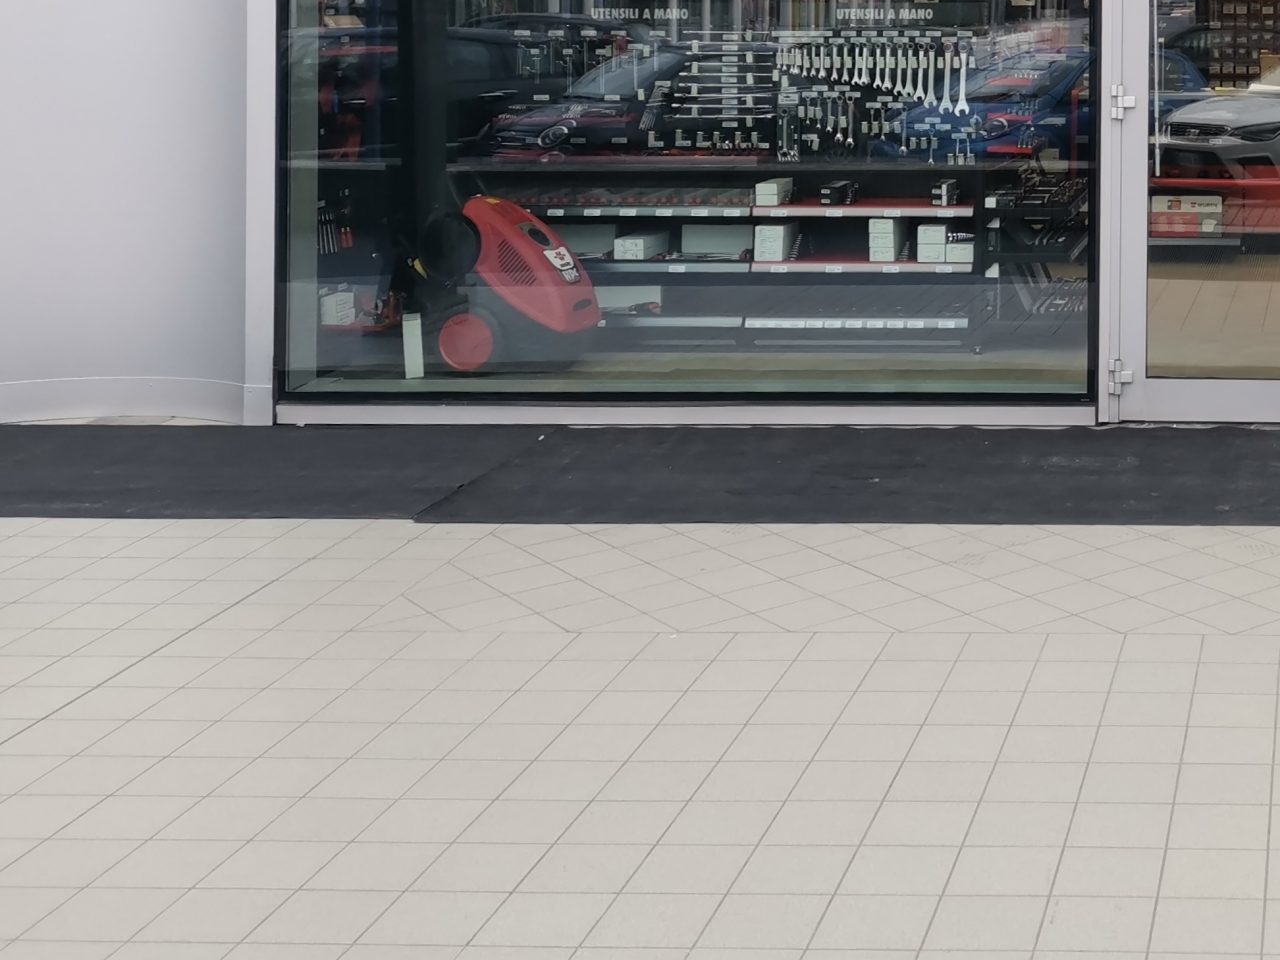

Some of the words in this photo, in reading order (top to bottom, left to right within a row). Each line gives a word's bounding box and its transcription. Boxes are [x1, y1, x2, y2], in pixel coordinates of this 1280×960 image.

[590, 7, 639, 19] UTENSILI
[642, 8, 651, 19] A
[653, 8, 689, 19] MANO
[836, 8, 884, 20] UTENSILI
[887, 8, 896, 20] A
[899, 8, 934, 20] MANO
